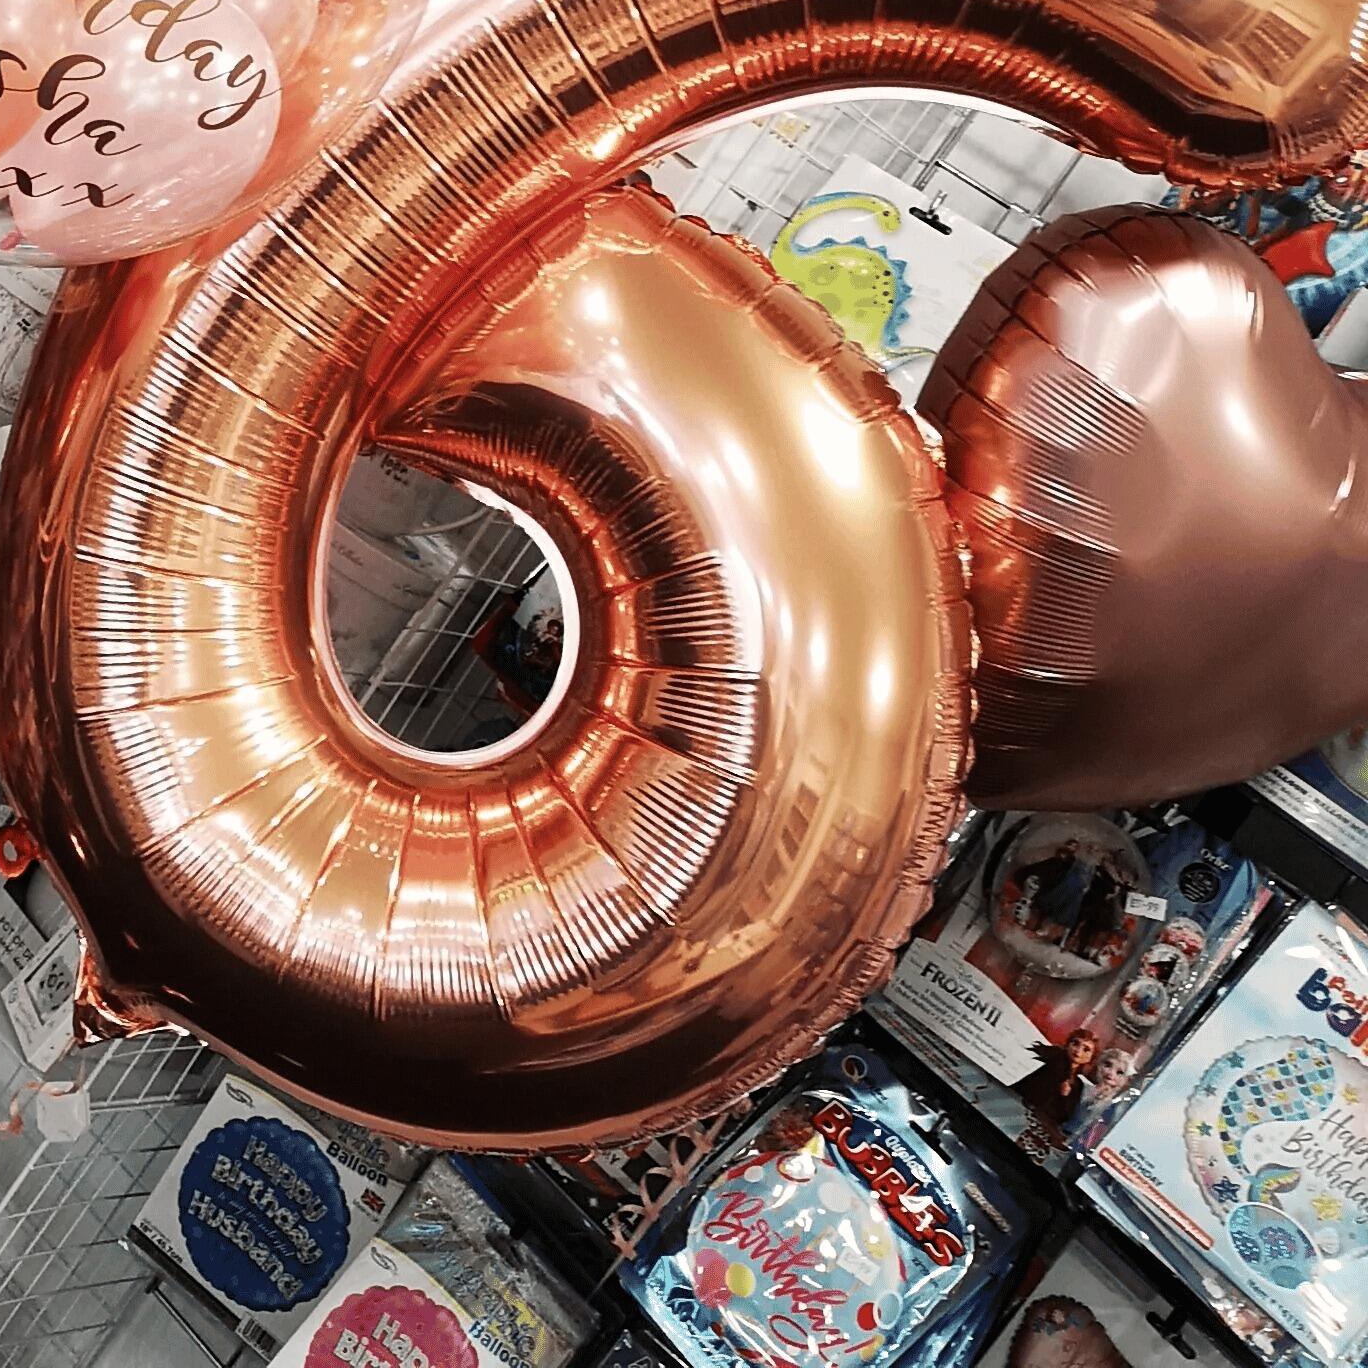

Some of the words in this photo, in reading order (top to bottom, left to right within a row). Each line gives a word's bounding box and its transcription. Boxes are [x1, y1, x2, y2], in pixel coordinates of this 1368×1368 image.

[920, 961, 989, 1017] FROZEN
[241, 1136, 328, 1223] Happy
[326, 1141, 389, 1185] Balloon
[210, 1152, 323, 1264] Birthday
[186, 1190, 303, 1301] Husband
[372, 1312, 436, 1368] Hap
